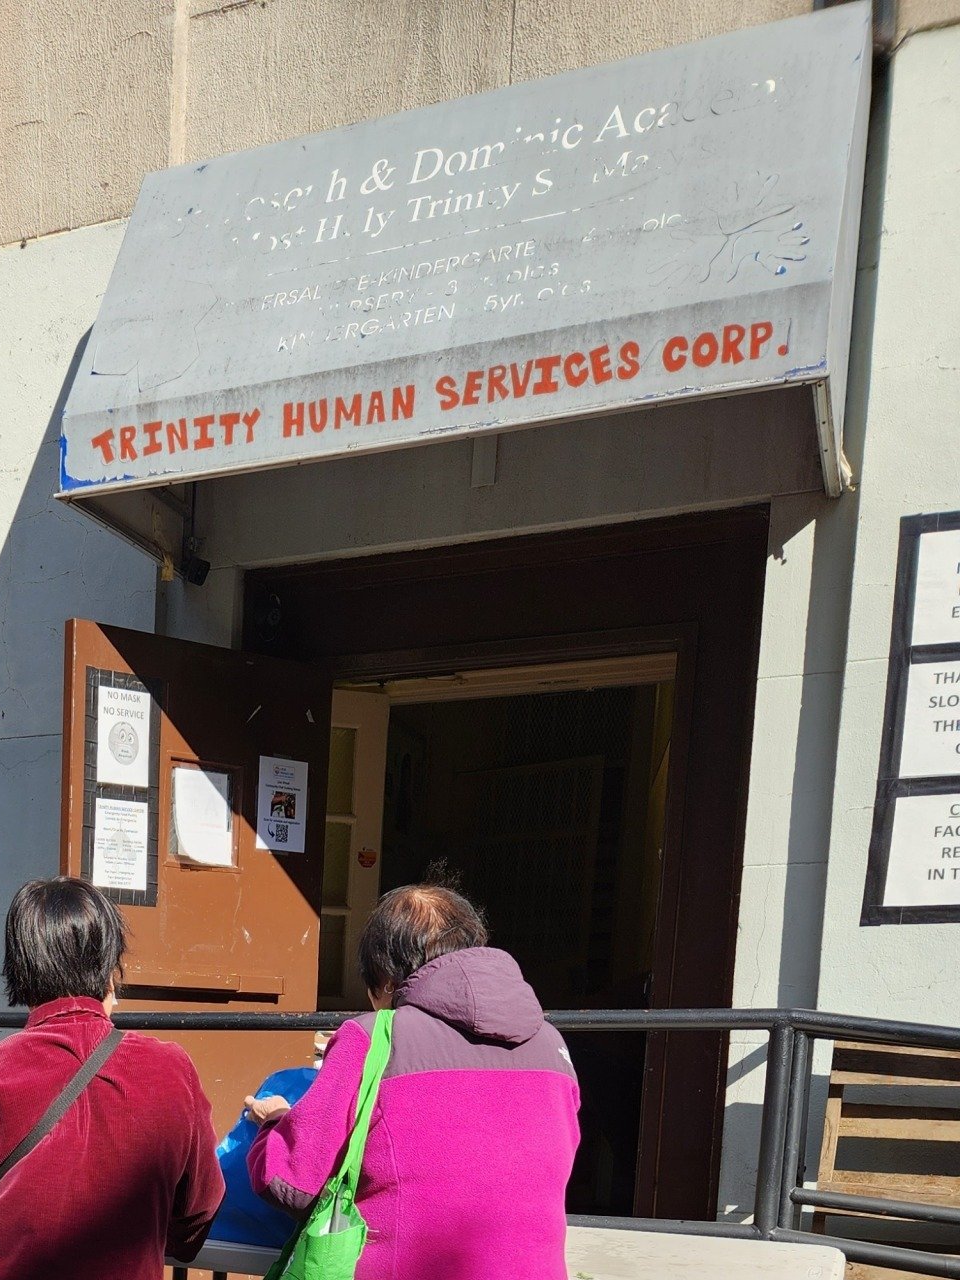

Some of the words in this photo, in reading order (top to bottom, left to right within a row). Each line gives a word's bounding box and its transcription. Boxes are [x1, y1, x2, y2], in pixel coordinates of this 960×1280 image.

[359, 158, 396, 196] &
[407, 117, 584, 185] Domnic
[313, 204, 396, 244] Hly
[406, 182, 522, 223] Triniy
[90, 408, 262, 465] TRINITY
[282, 384, 417, 440] HUMAN
[434, 340, 641, 412] SERVICES
[662, 320, 790, 374] CORP.
[103, 706, 115, 715] NO
[116, 708, 145, 720] SERVICE
[107, 690, 119, 700] NO
[121, 693, 142, 703] MASK
[927, 868, 945, 881] IN
